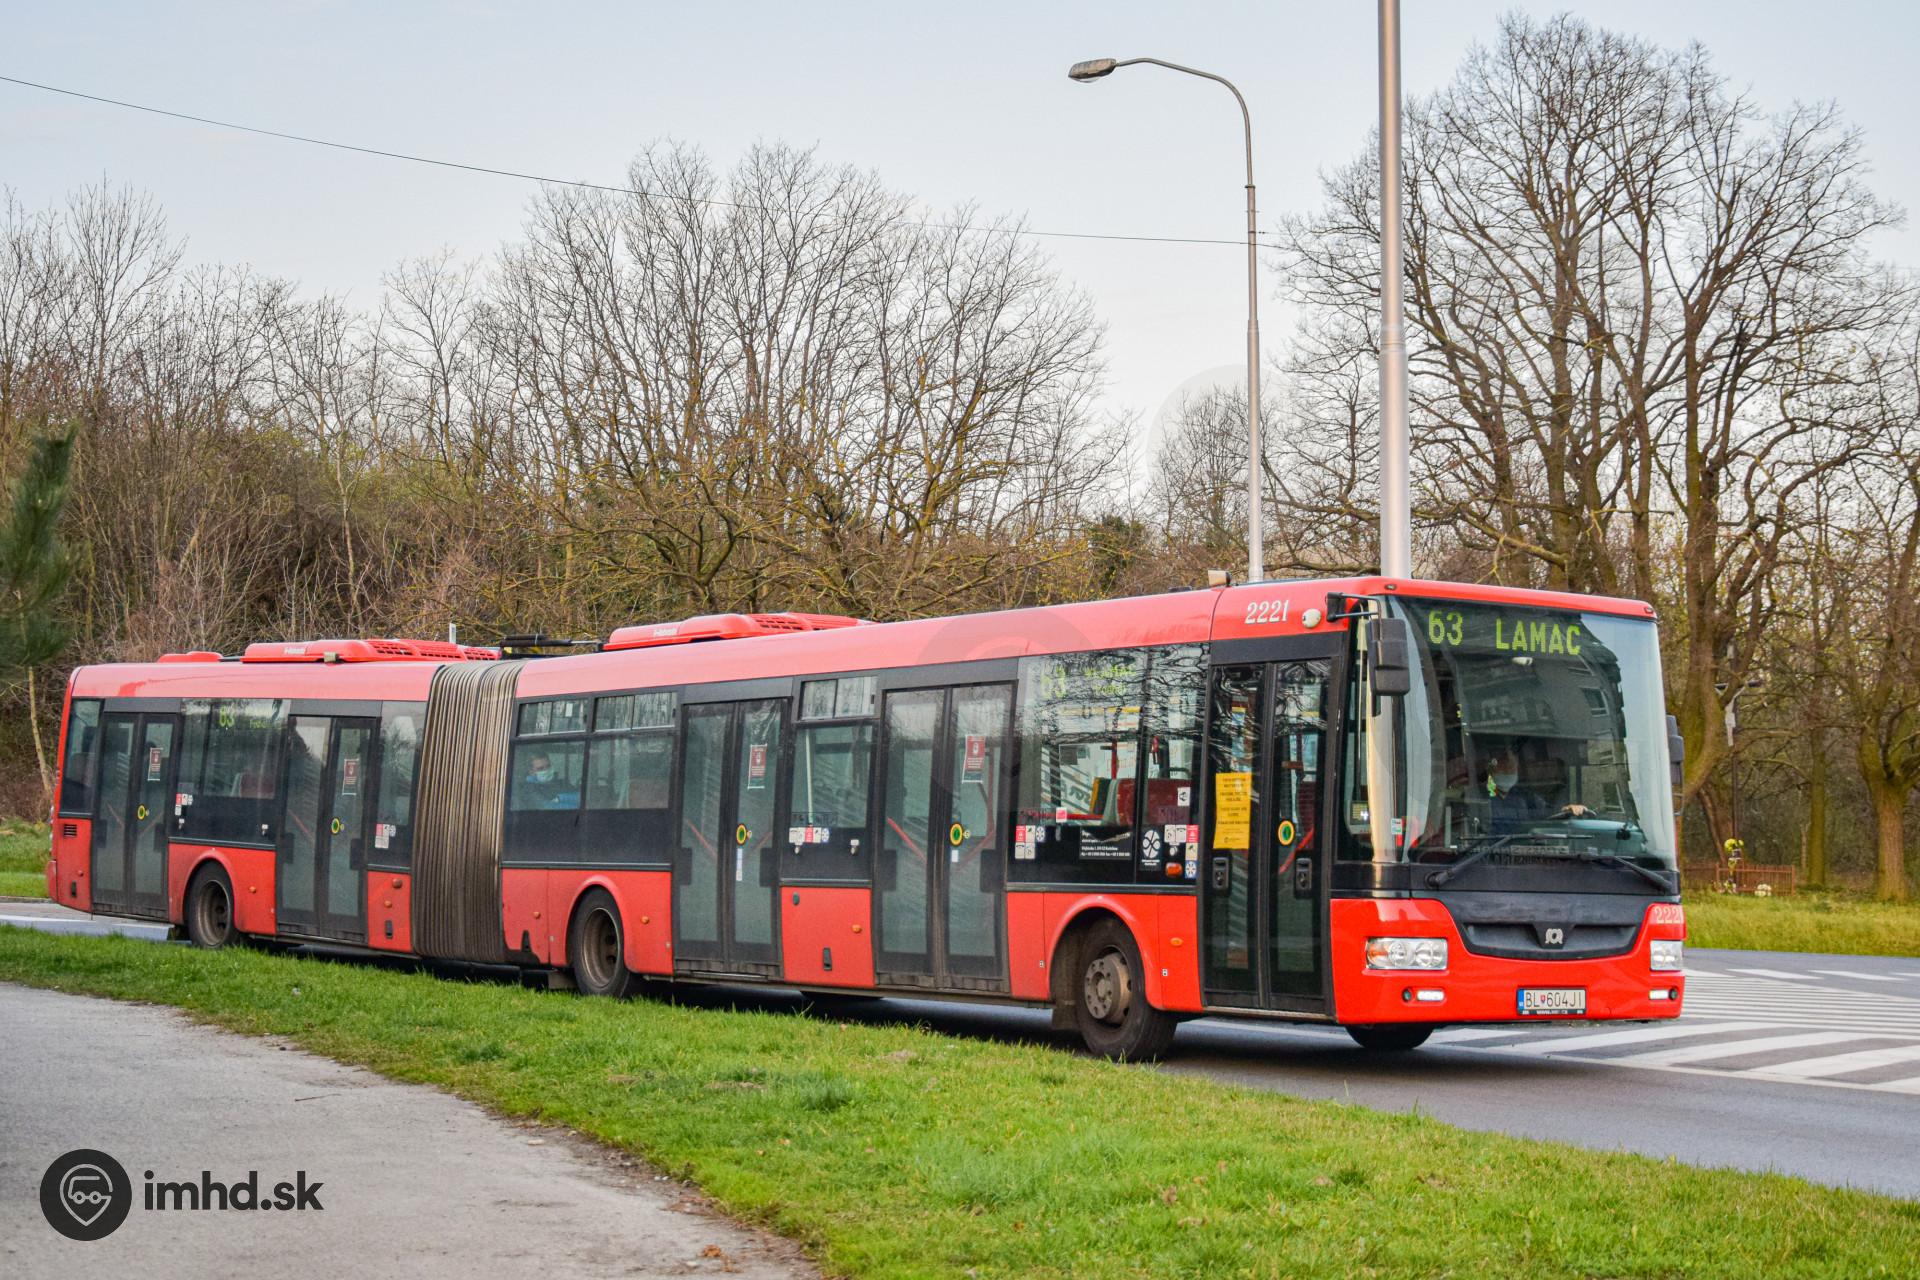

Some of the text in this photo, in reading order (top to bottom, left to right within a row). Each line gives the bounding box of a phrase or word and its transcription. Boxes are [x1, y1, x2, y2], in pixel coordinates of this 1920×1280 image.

[1245, 599, 1290, 624] 2221
[1428, 610, 1581, 655] 63 LAMAC
[1525, 992, 1540, 1008] BL
